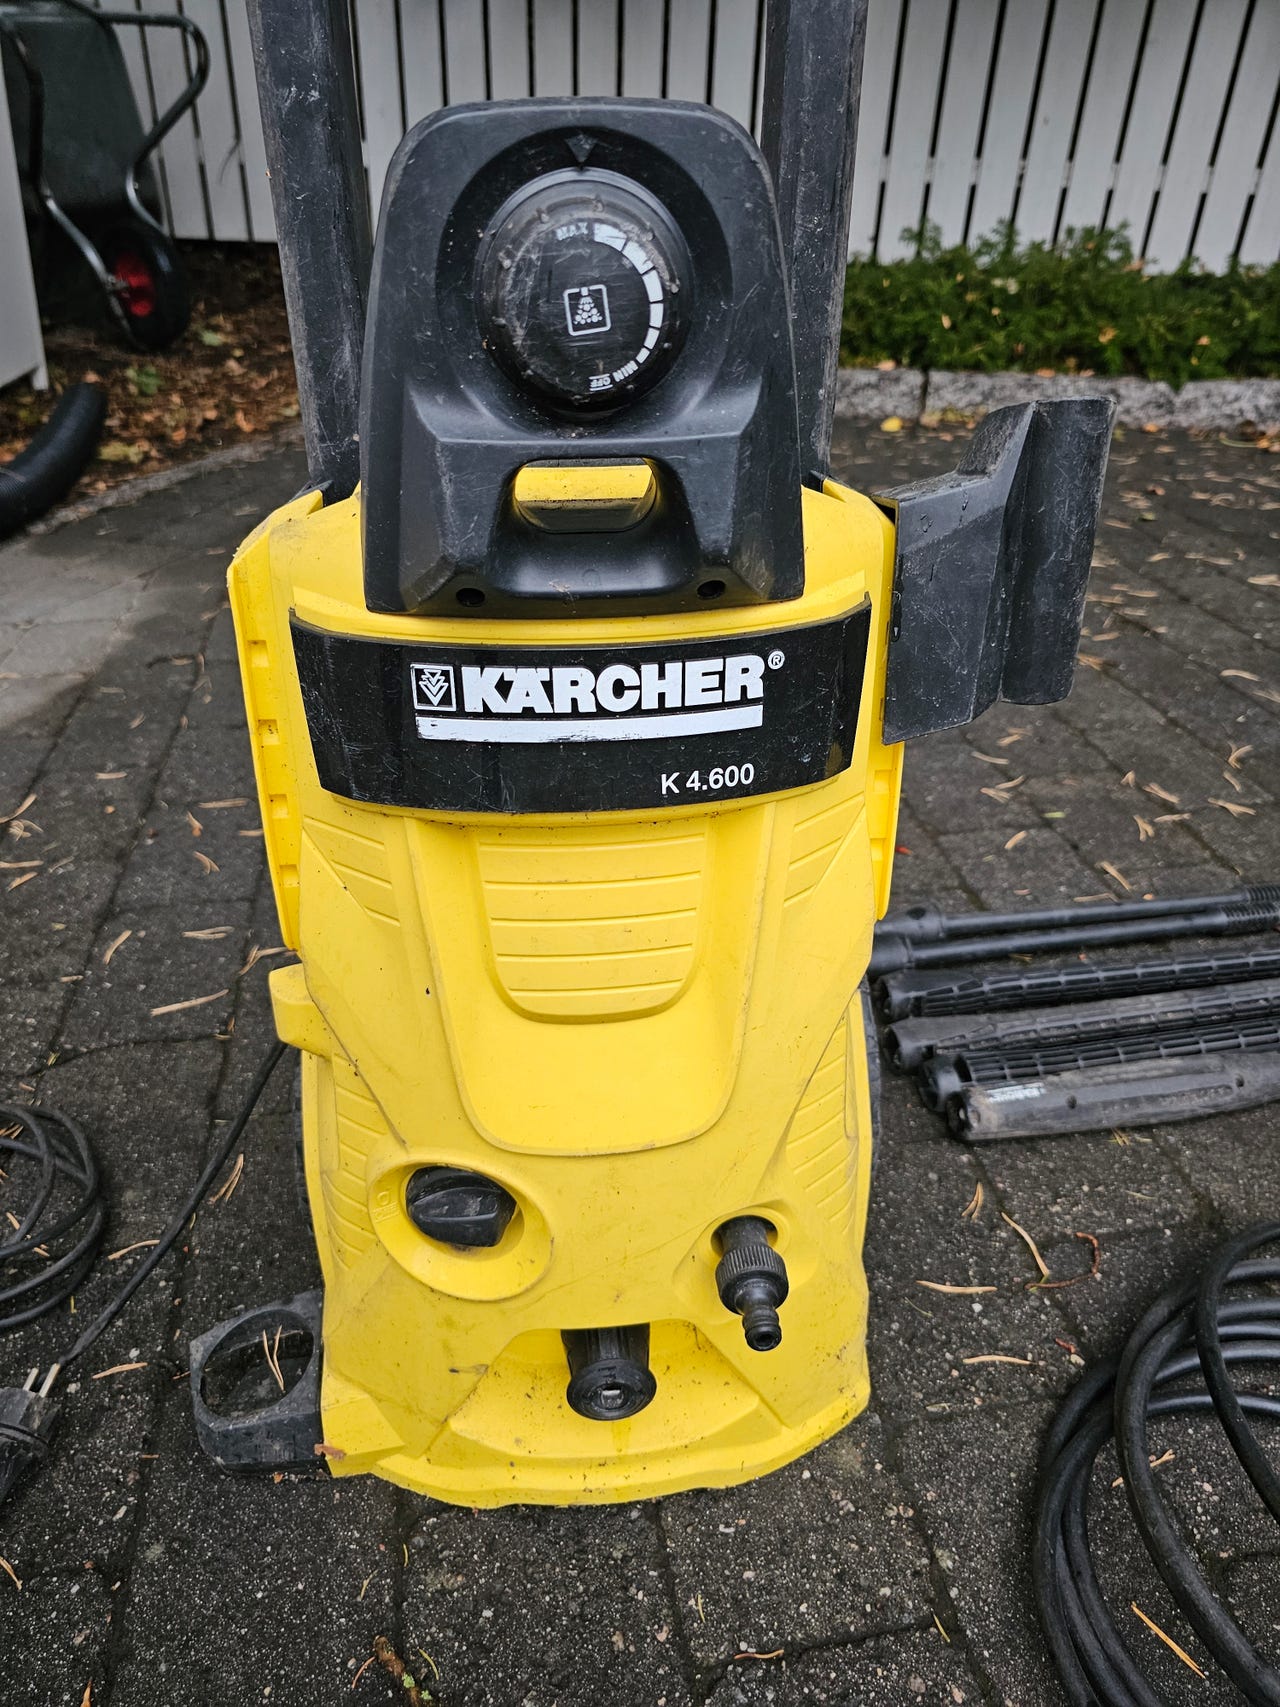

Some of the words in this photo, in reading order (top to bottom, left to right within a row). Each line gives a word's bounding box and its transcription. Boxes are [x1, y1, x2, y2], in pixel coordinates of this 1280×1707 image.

[555, 222, 589, 241] MAX
[612, 360, 638, 382] MIN
[590, 376, 612, 388] OFF
[660, 773, 681, 796] K
[685, 763, 755, 792] 4.600
